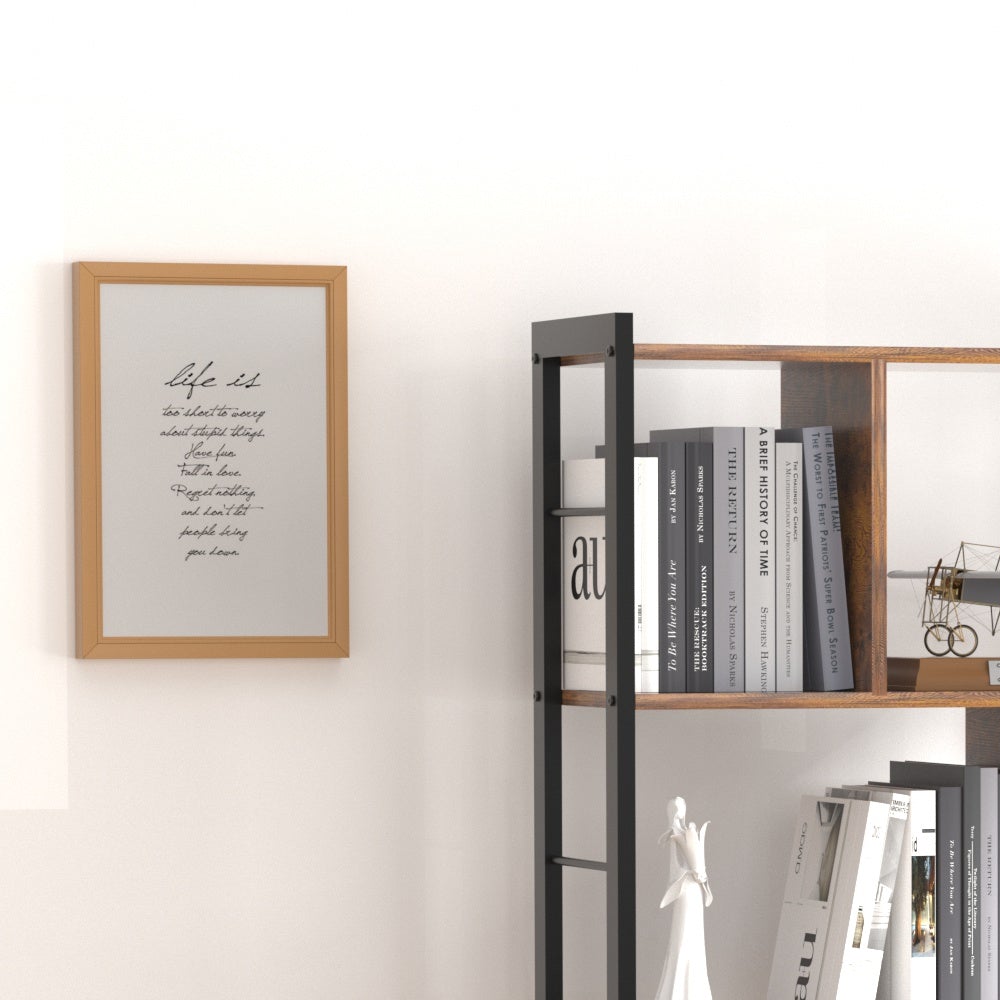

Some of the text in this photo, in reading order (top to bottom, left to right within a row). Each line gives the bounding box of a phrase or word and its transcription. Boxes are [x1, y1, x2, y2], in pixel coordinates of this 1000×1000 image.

[164, 361, 261, 400] life is
[162, 404, 265, 423] too short to worry
[160, 424, 193, 437] about
[191, 424, 228, 440] stupid
[184, 441, 214, 460] Have
[177, 462, 242, 477] Fall in love.
[170, 484, 217, 502] Regret
[728, 447, 737, 554] THE RETURN
[759, 427, 768, 576] A BRIEF HISTORY OF TIME
[181, 503, 263, 516] and don't let
[178, 523, 248, 541] people bring
[185, 549, 206, 561] you
[667, 560, 677, 671] To Be Where You Are
[949, 840, 954, 848] To
[949, 850, 954, 860] Be
